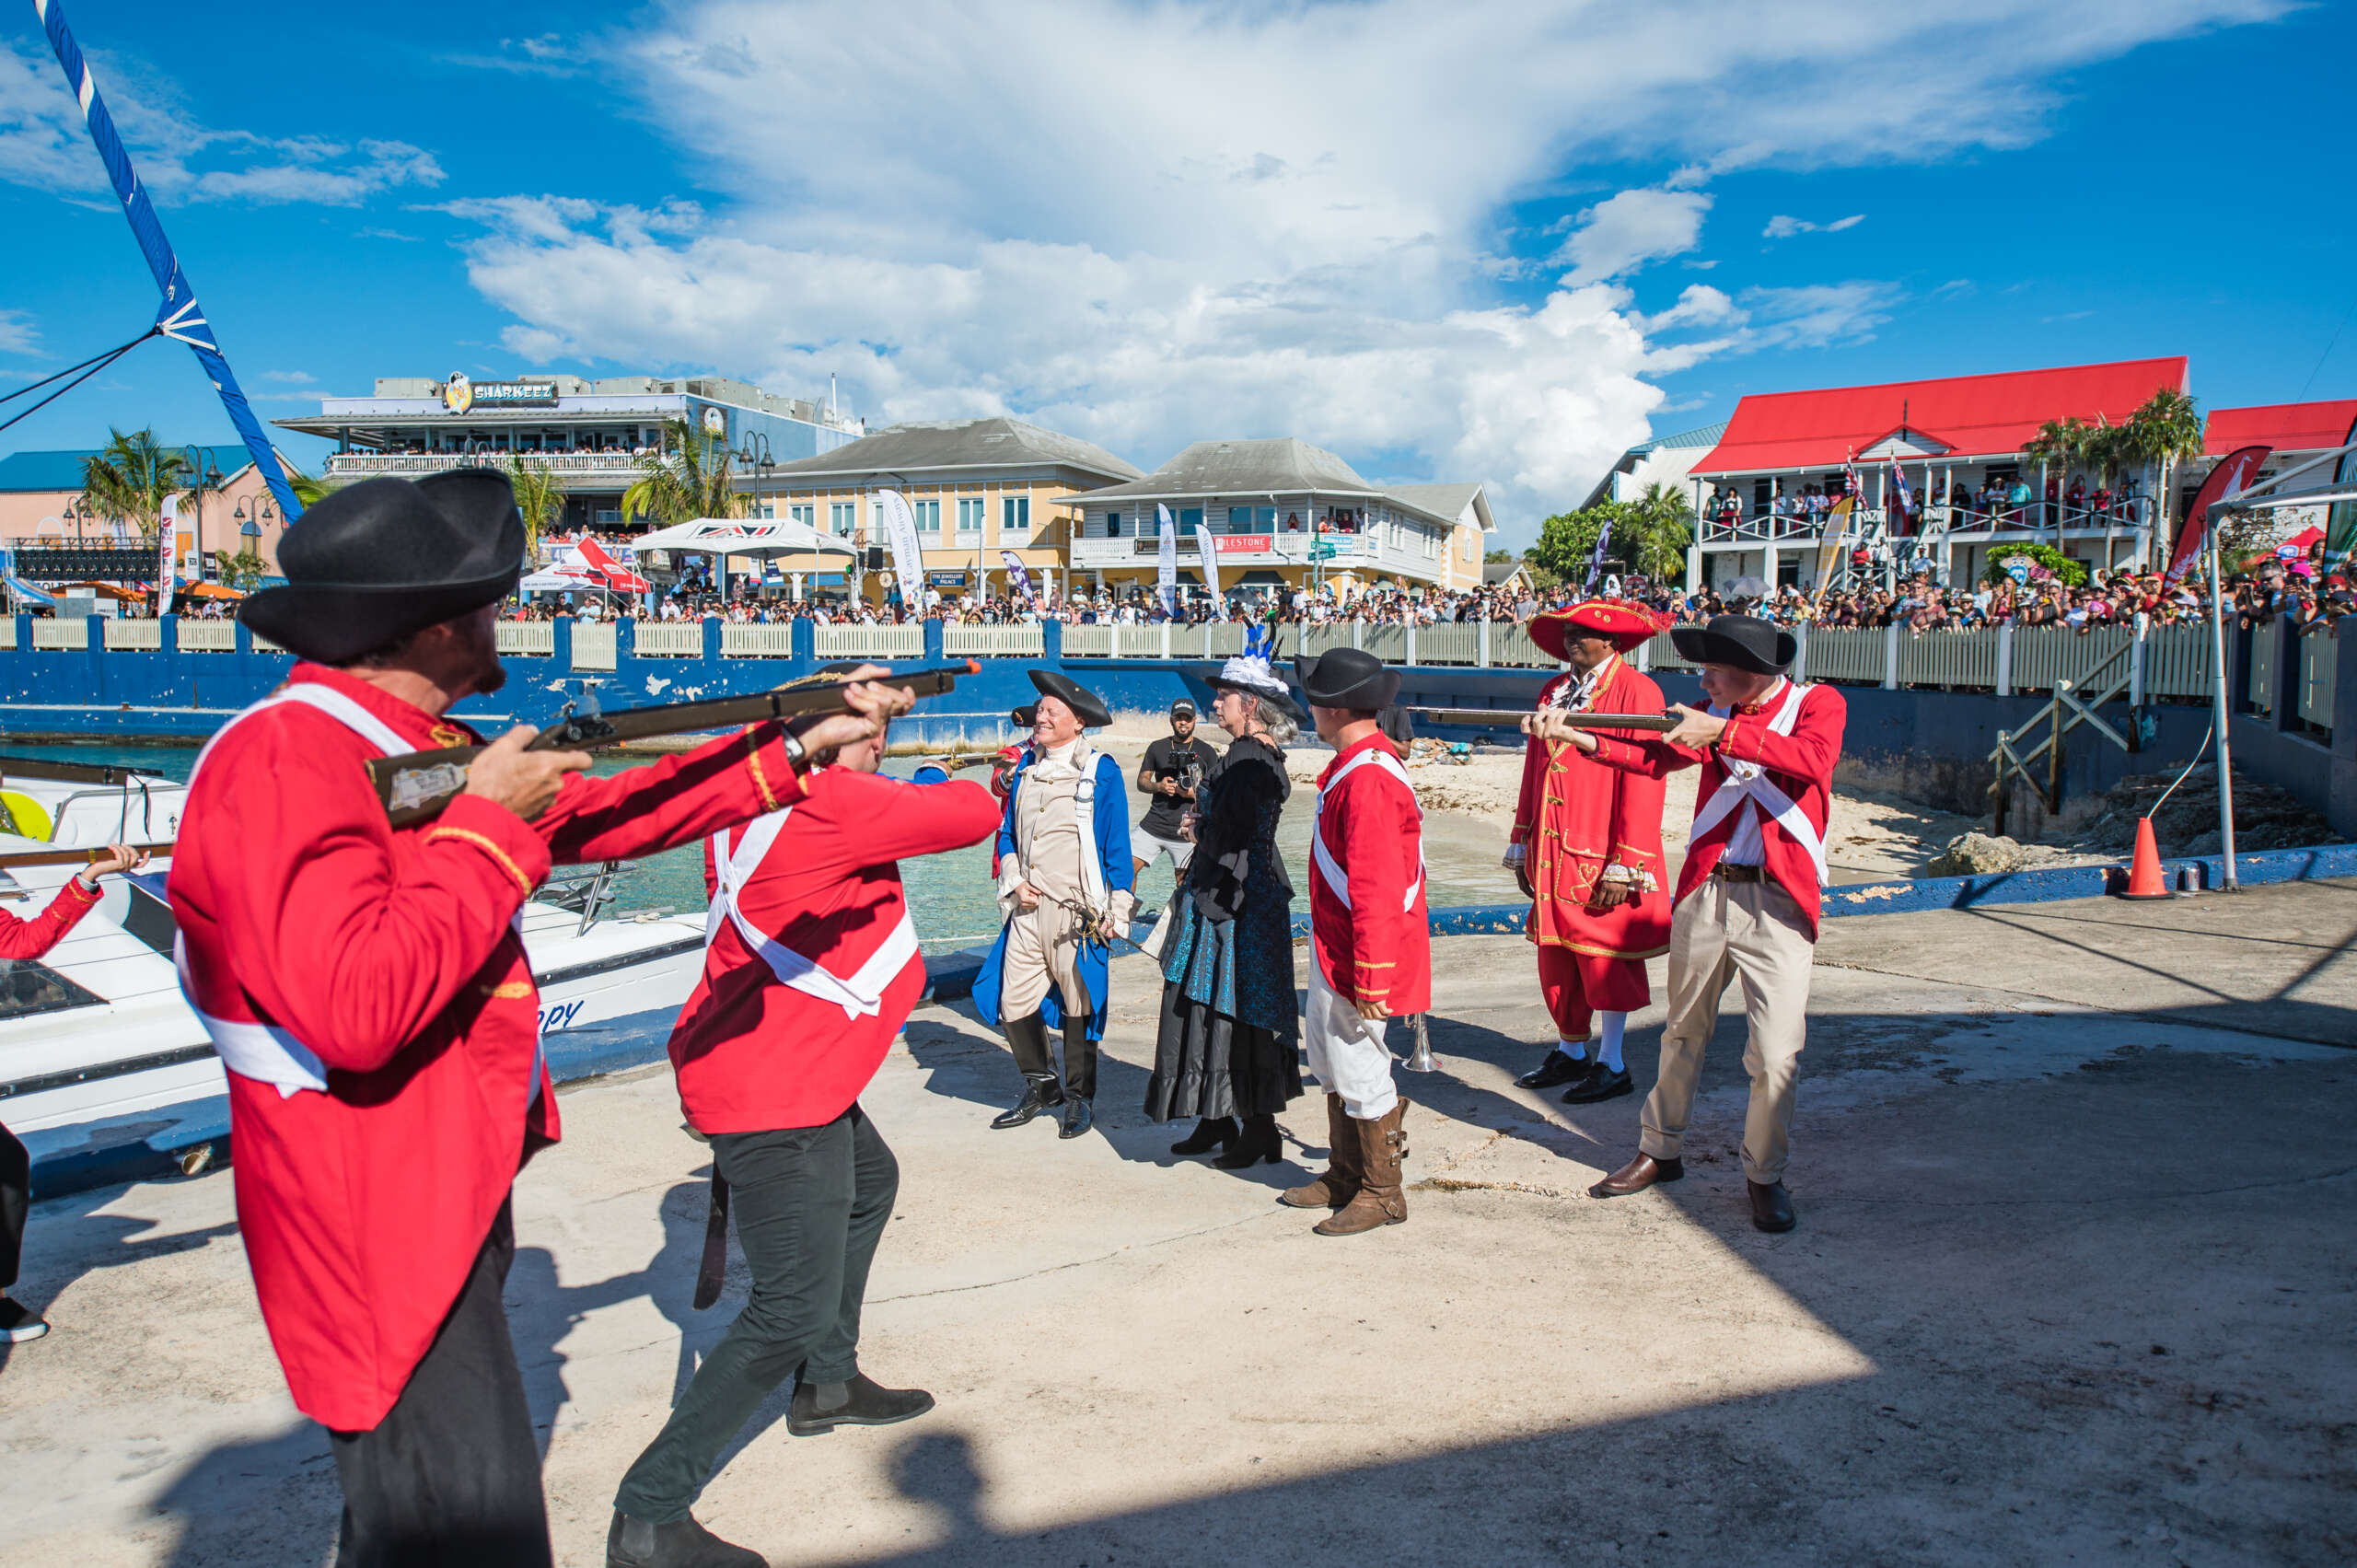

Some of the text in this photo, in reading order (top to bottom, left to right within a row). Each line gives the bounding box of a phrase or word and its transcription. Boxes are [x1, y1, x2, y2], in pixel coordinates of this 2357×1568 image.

[474, 385, 553, 400] SHARKEEZ
[893, 497, 906, 533] Airways
[902, 536, 913, 575] Cayman
[1215, 538, 1265, 549] MILESTONE
